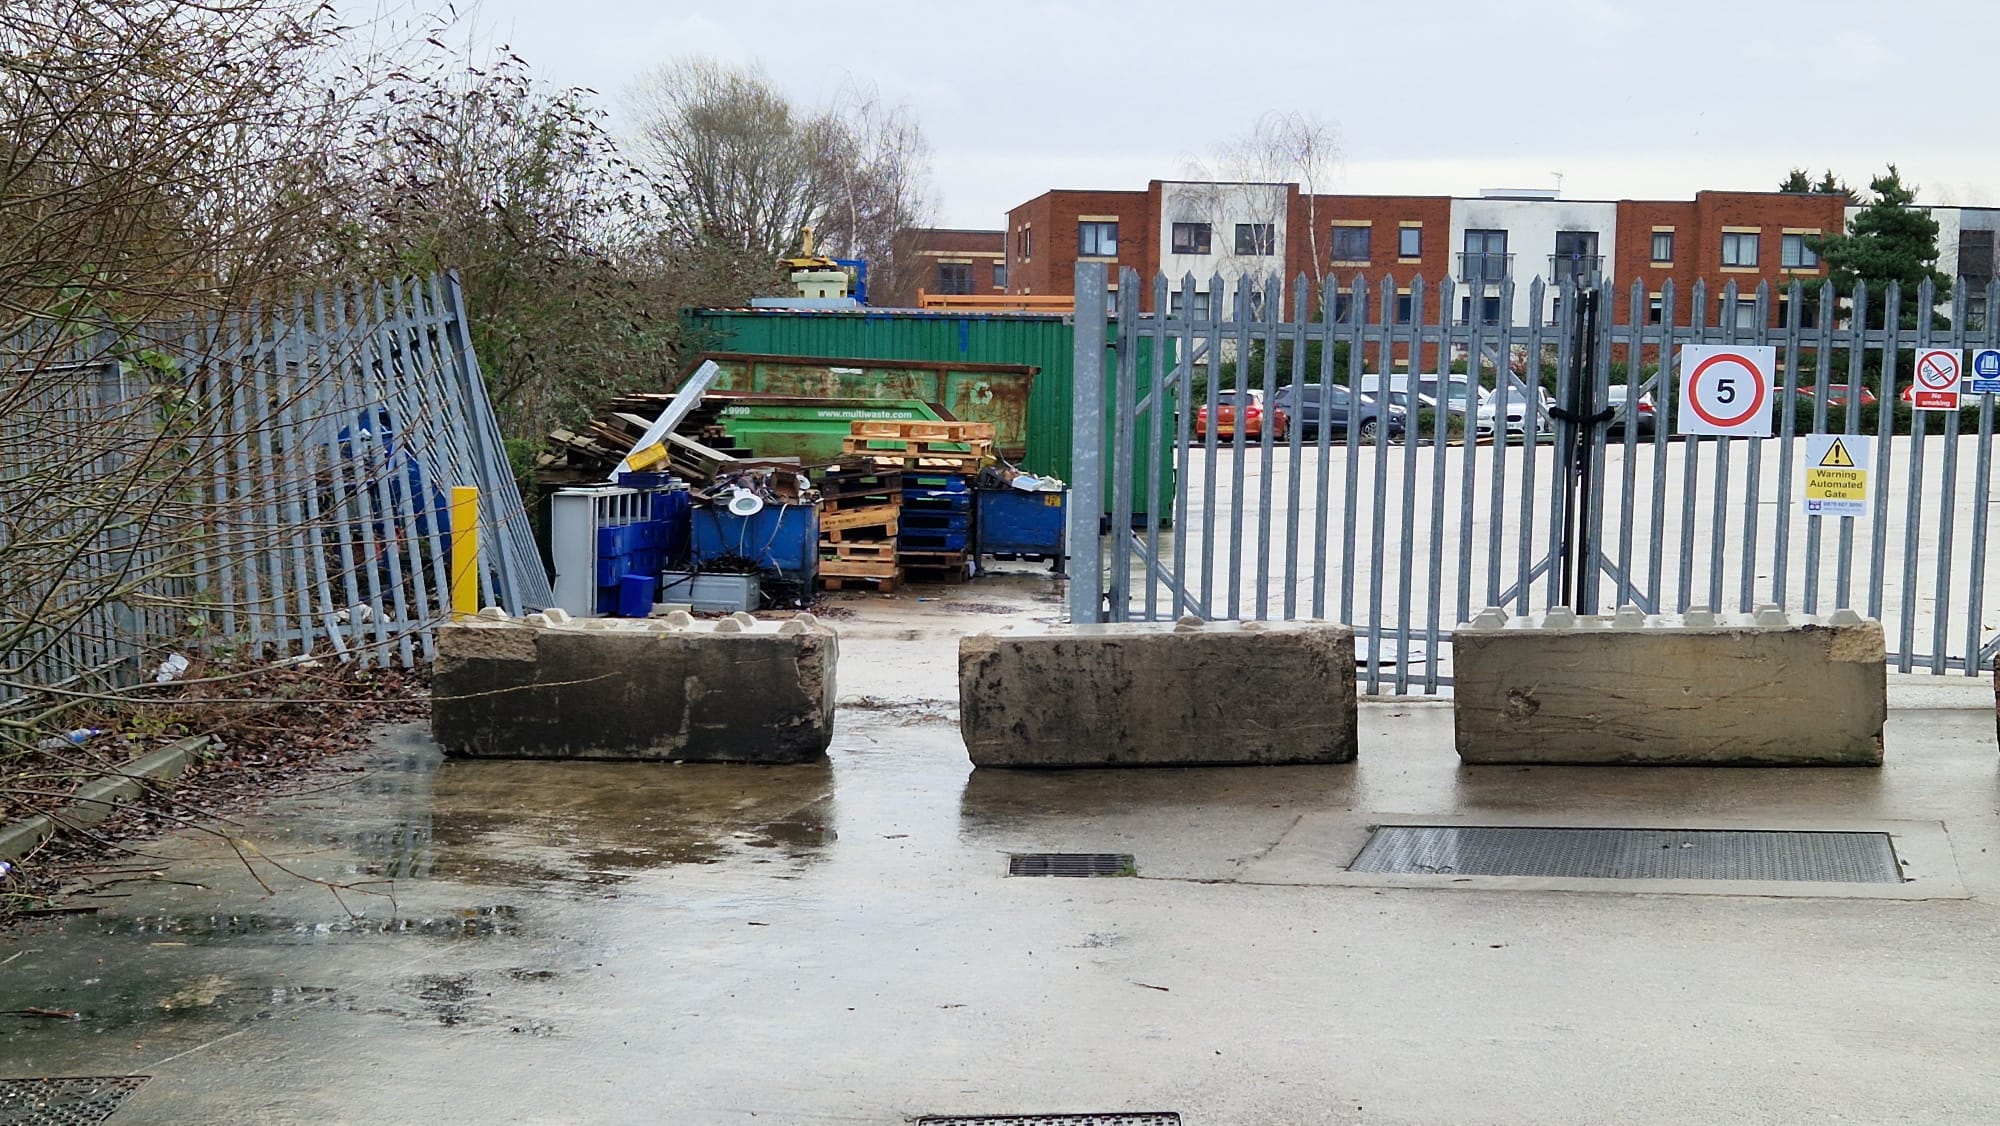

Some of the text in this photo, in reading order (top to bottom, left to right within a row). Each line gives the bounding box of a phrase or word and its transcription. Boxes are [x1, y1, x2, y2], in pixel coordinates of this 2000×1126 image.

[1716, 378, 1736, 404] 5
[817, 410, 912, 419] www.multiwaste.com
[1816, 469, 1857, 480] Warning
[1809, 479, 1863, 489] Automated
[1824, 489, 1848, 498] Gate
